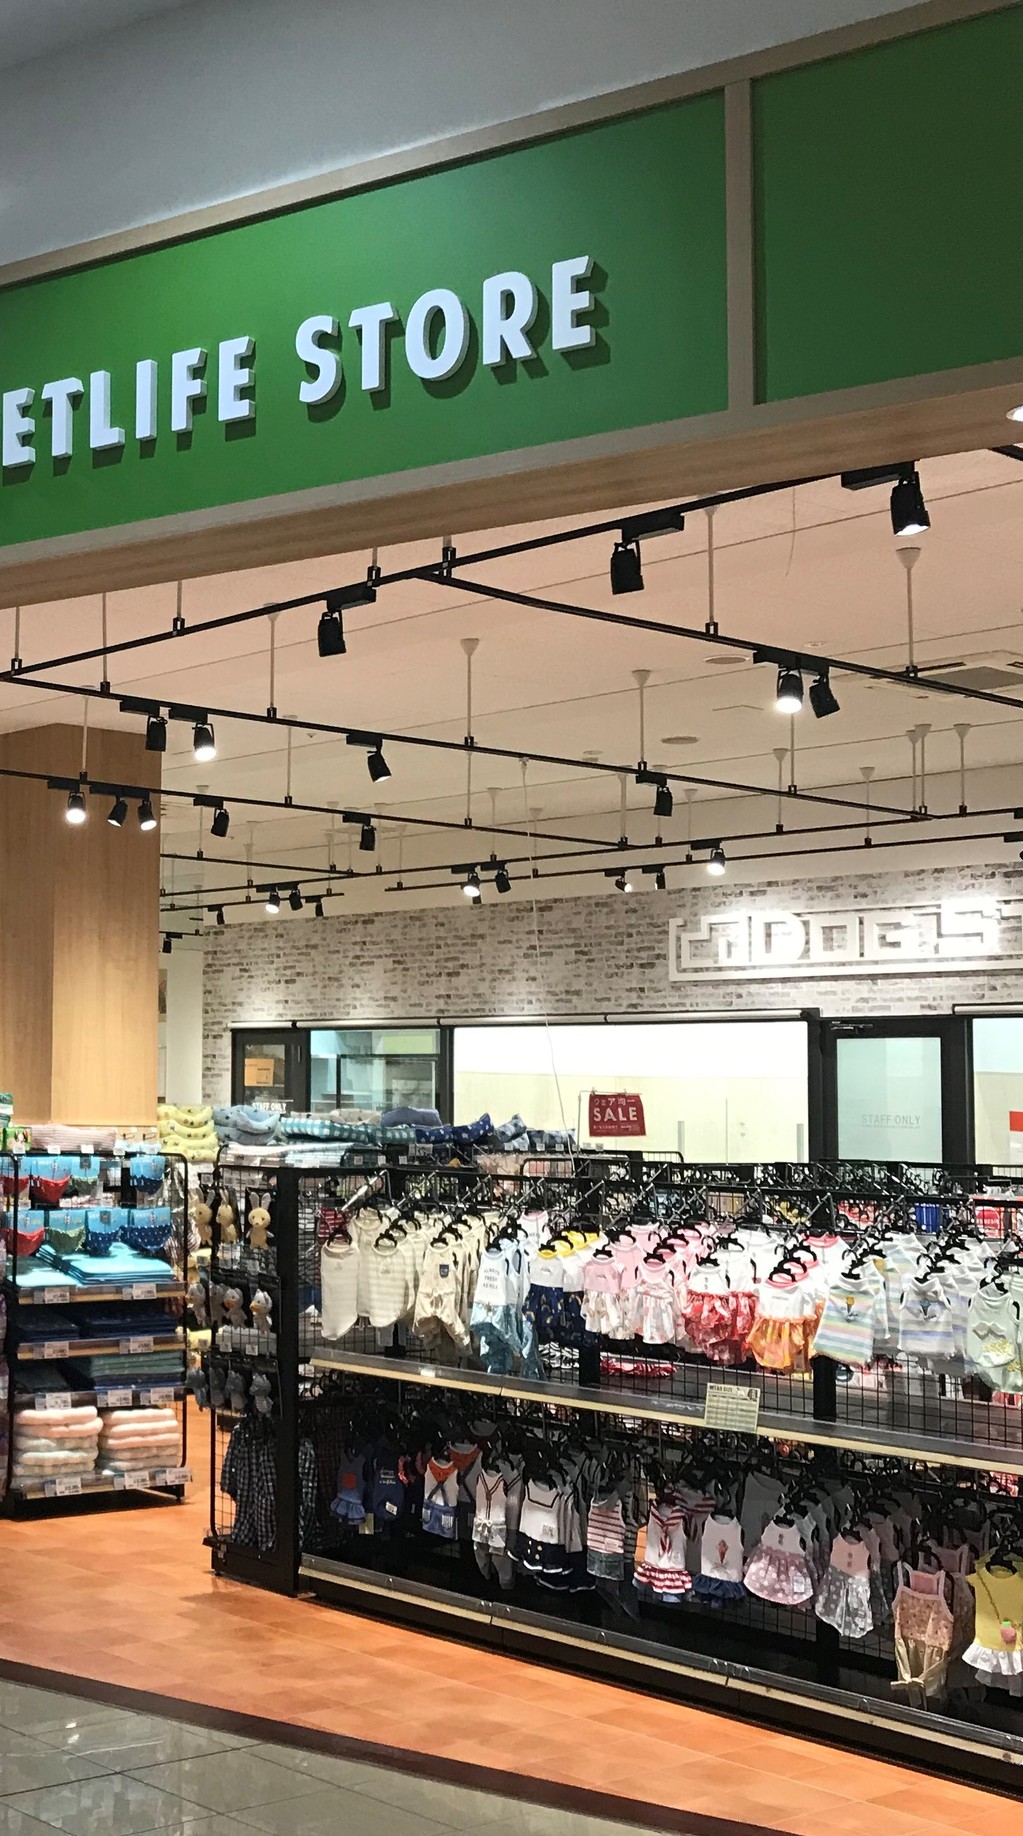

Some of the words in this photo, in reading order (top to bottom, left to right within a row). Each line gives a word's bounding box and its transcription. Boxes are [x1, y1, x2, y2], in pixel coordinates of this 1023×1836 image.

[296, 255, 596, 406] STORE
[593, 1106, 638, 1122] SALE
[862, 1113, 892, 1124] STAFF
[894, 1114, 921, 1125] ONLY
